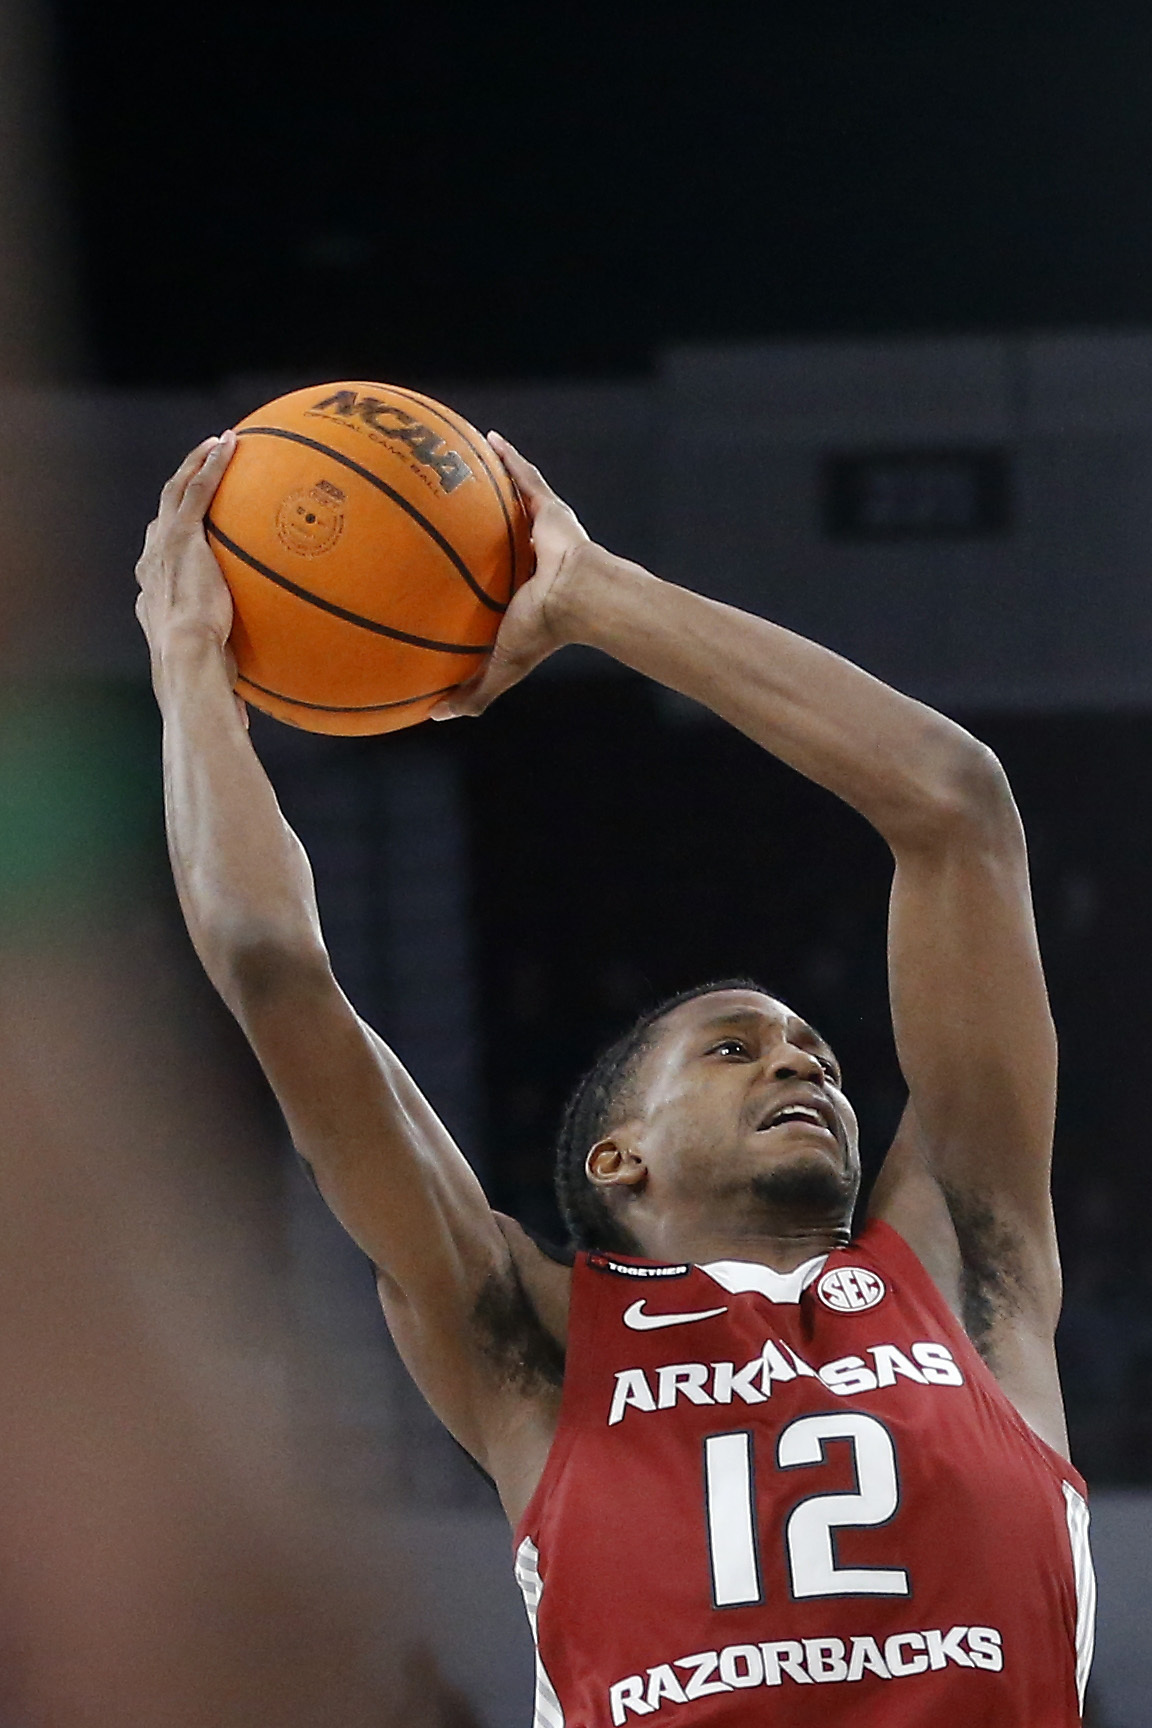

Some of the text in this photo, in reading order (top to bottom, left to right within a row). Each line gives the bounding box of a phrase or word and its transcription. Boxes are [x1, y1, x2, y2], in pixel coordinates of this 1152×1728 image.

[311, 390, 473, 495] NCAA
[608, 1261, 687, 1277] TOGETHER
[821, 1270, 877, 1310] SEC
[704, 1411, 911, 1608] 12
[609, 1627, 1003, 1727] RAZORBACKS
